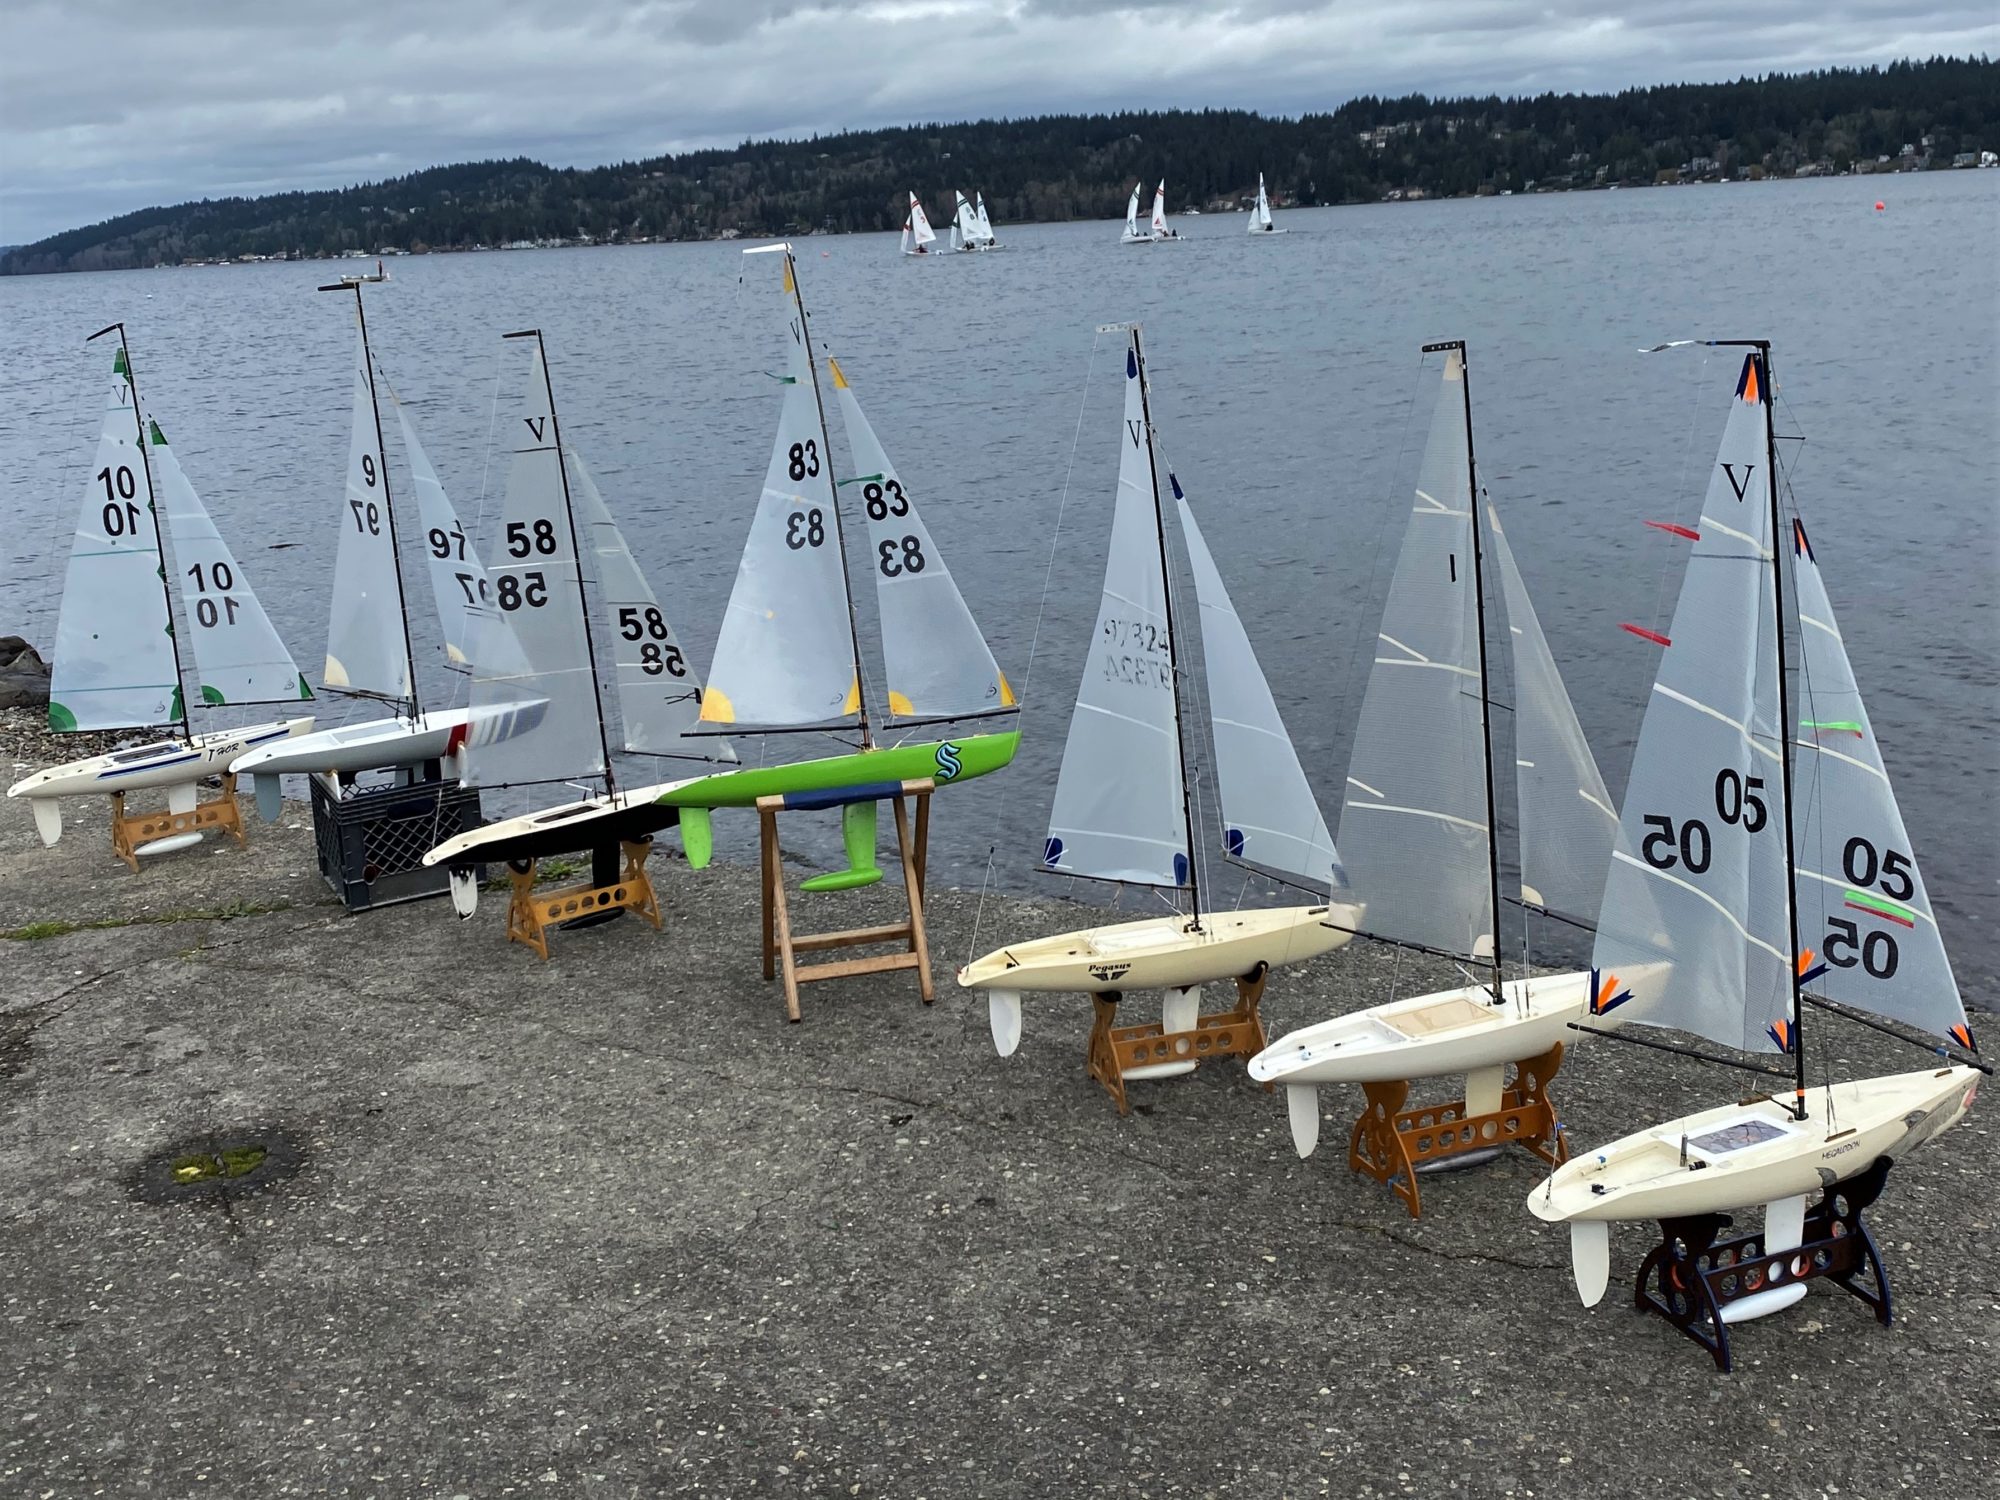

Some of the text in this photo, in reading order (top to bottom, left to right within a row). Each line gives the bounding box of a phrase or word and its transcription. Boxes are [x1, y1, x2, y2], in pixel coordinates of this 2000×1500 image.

[112, 385, 128, 405] V
[523, 416, 546, 442] V
[1127, 419, 1141, 450] V
[788, 438, 820, 481] 83
[97, 465, 136, 500] 10
[862, 479, 910, 521] 83
[1720, 463, 1756, 503] V
[428, 527, 466, 561] 97
[506, 518, 557, 558] 58
[187, 561, 234, 593] 10
[618, 607, 669, 642] 58
[209, 742, 240, 762] THOR
[1714, 768, 1768, 834] 05
[1842, 836, 1915, 901] 05
[1088, 962, 1132, 974] Pegasus
